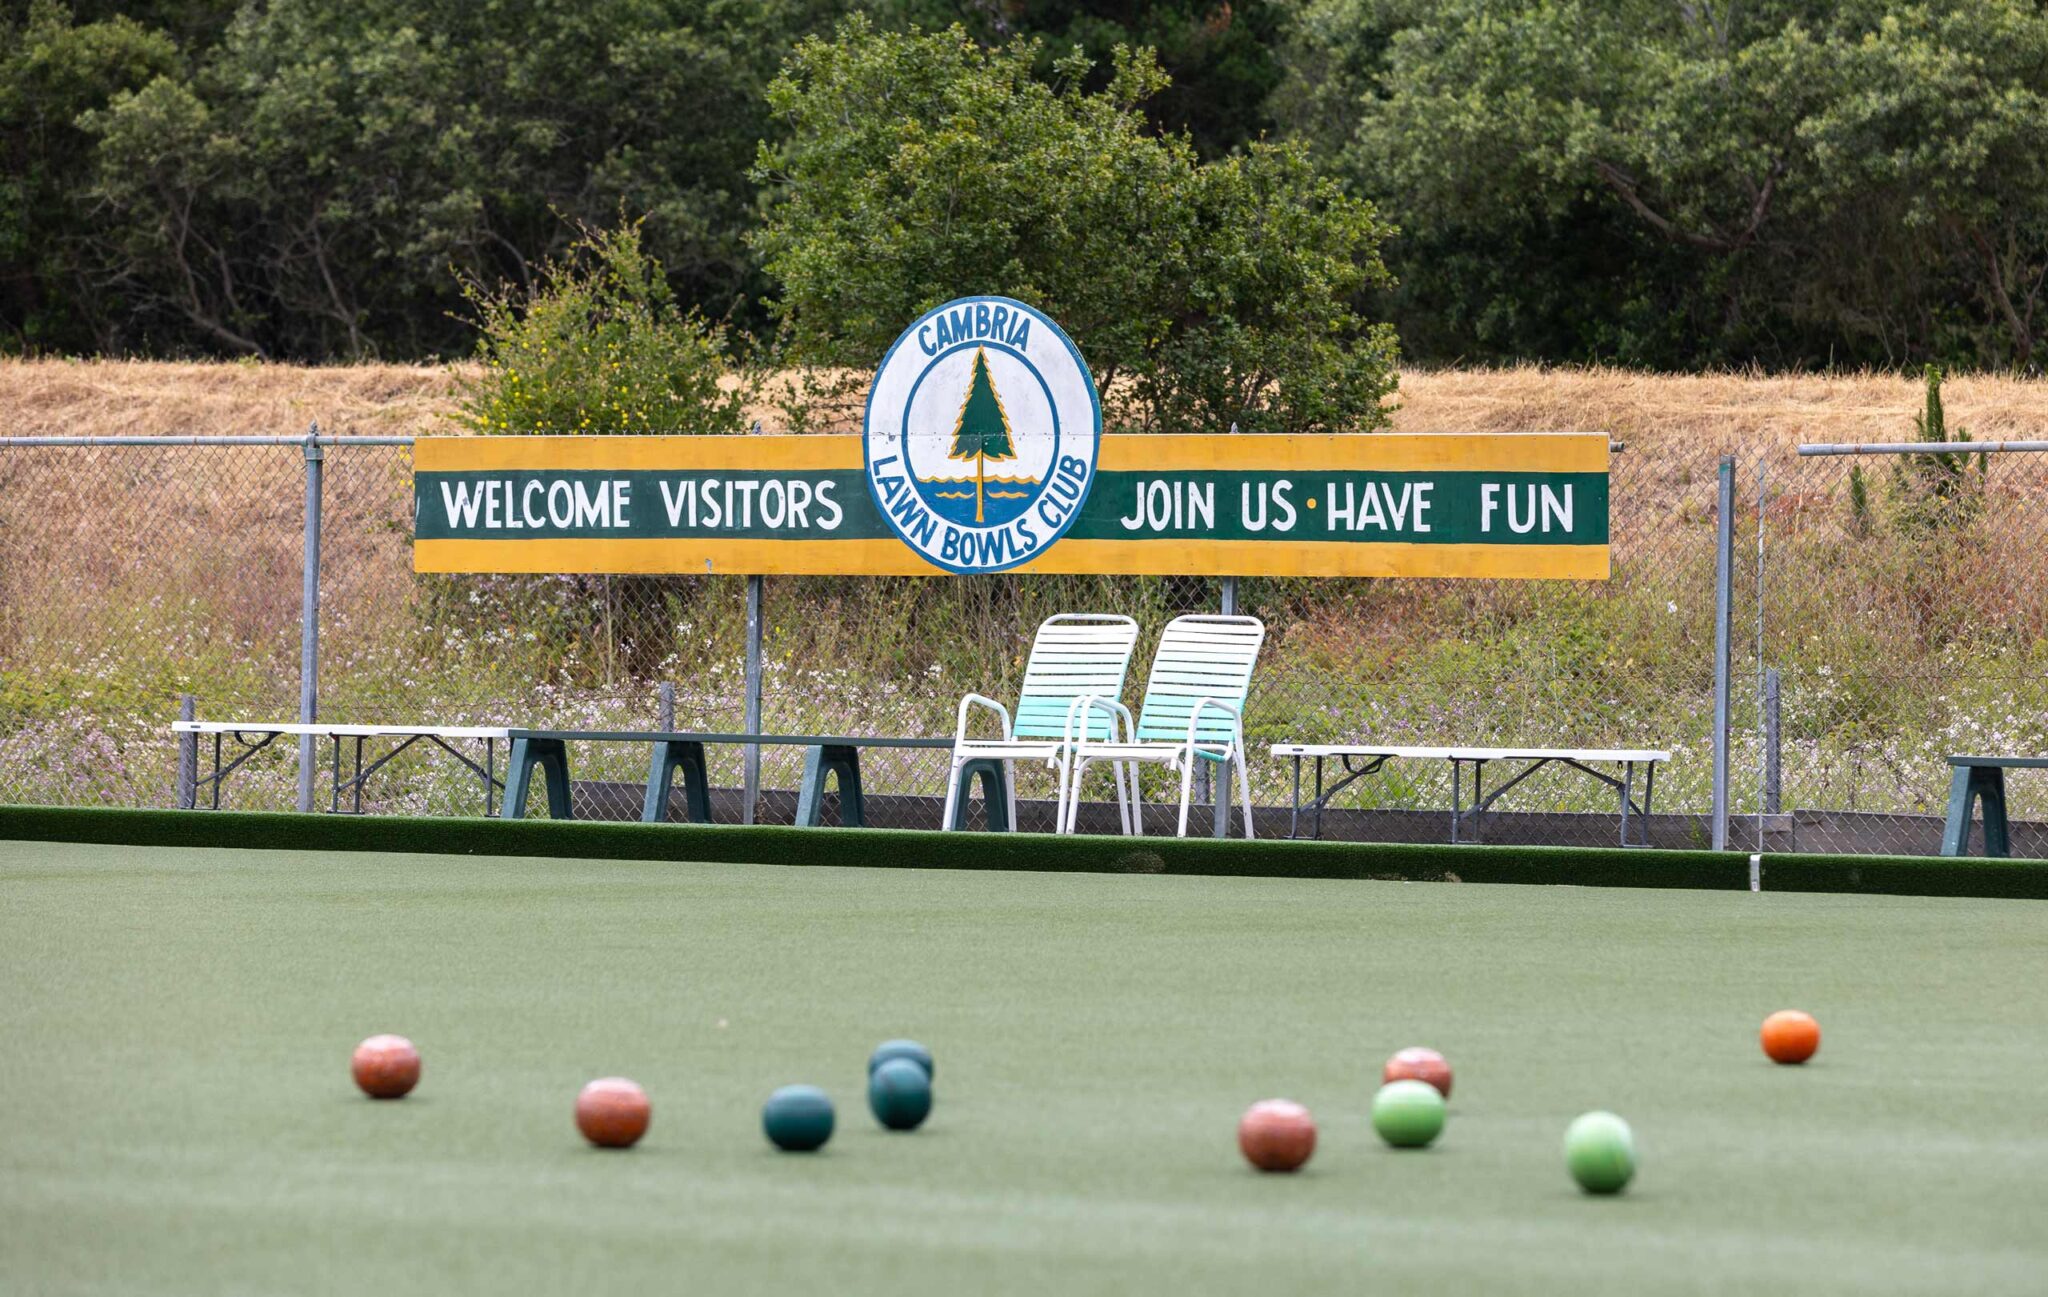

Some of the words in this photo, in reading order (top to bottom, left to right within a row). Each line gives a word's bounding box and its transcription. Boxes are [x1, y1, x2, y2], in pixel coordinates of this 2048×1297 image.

[918, 304, 1031, 356] CAMBRIA
[439, 478, 631, 529] WELCOME
[658, 478, 843, 531] VISITORS
[872, 455, 939, 548] LAWN
[940, 518, 1038, 566] BOWLS
[1037, 454, 1088, 529] CLUB
[1120, 479, 1215, 532] JOIN
[1241, 479, 1297, 532] US
[1327, 482, 1434, 533] HAVE
[1481, 483, 1573, 534] FUN
